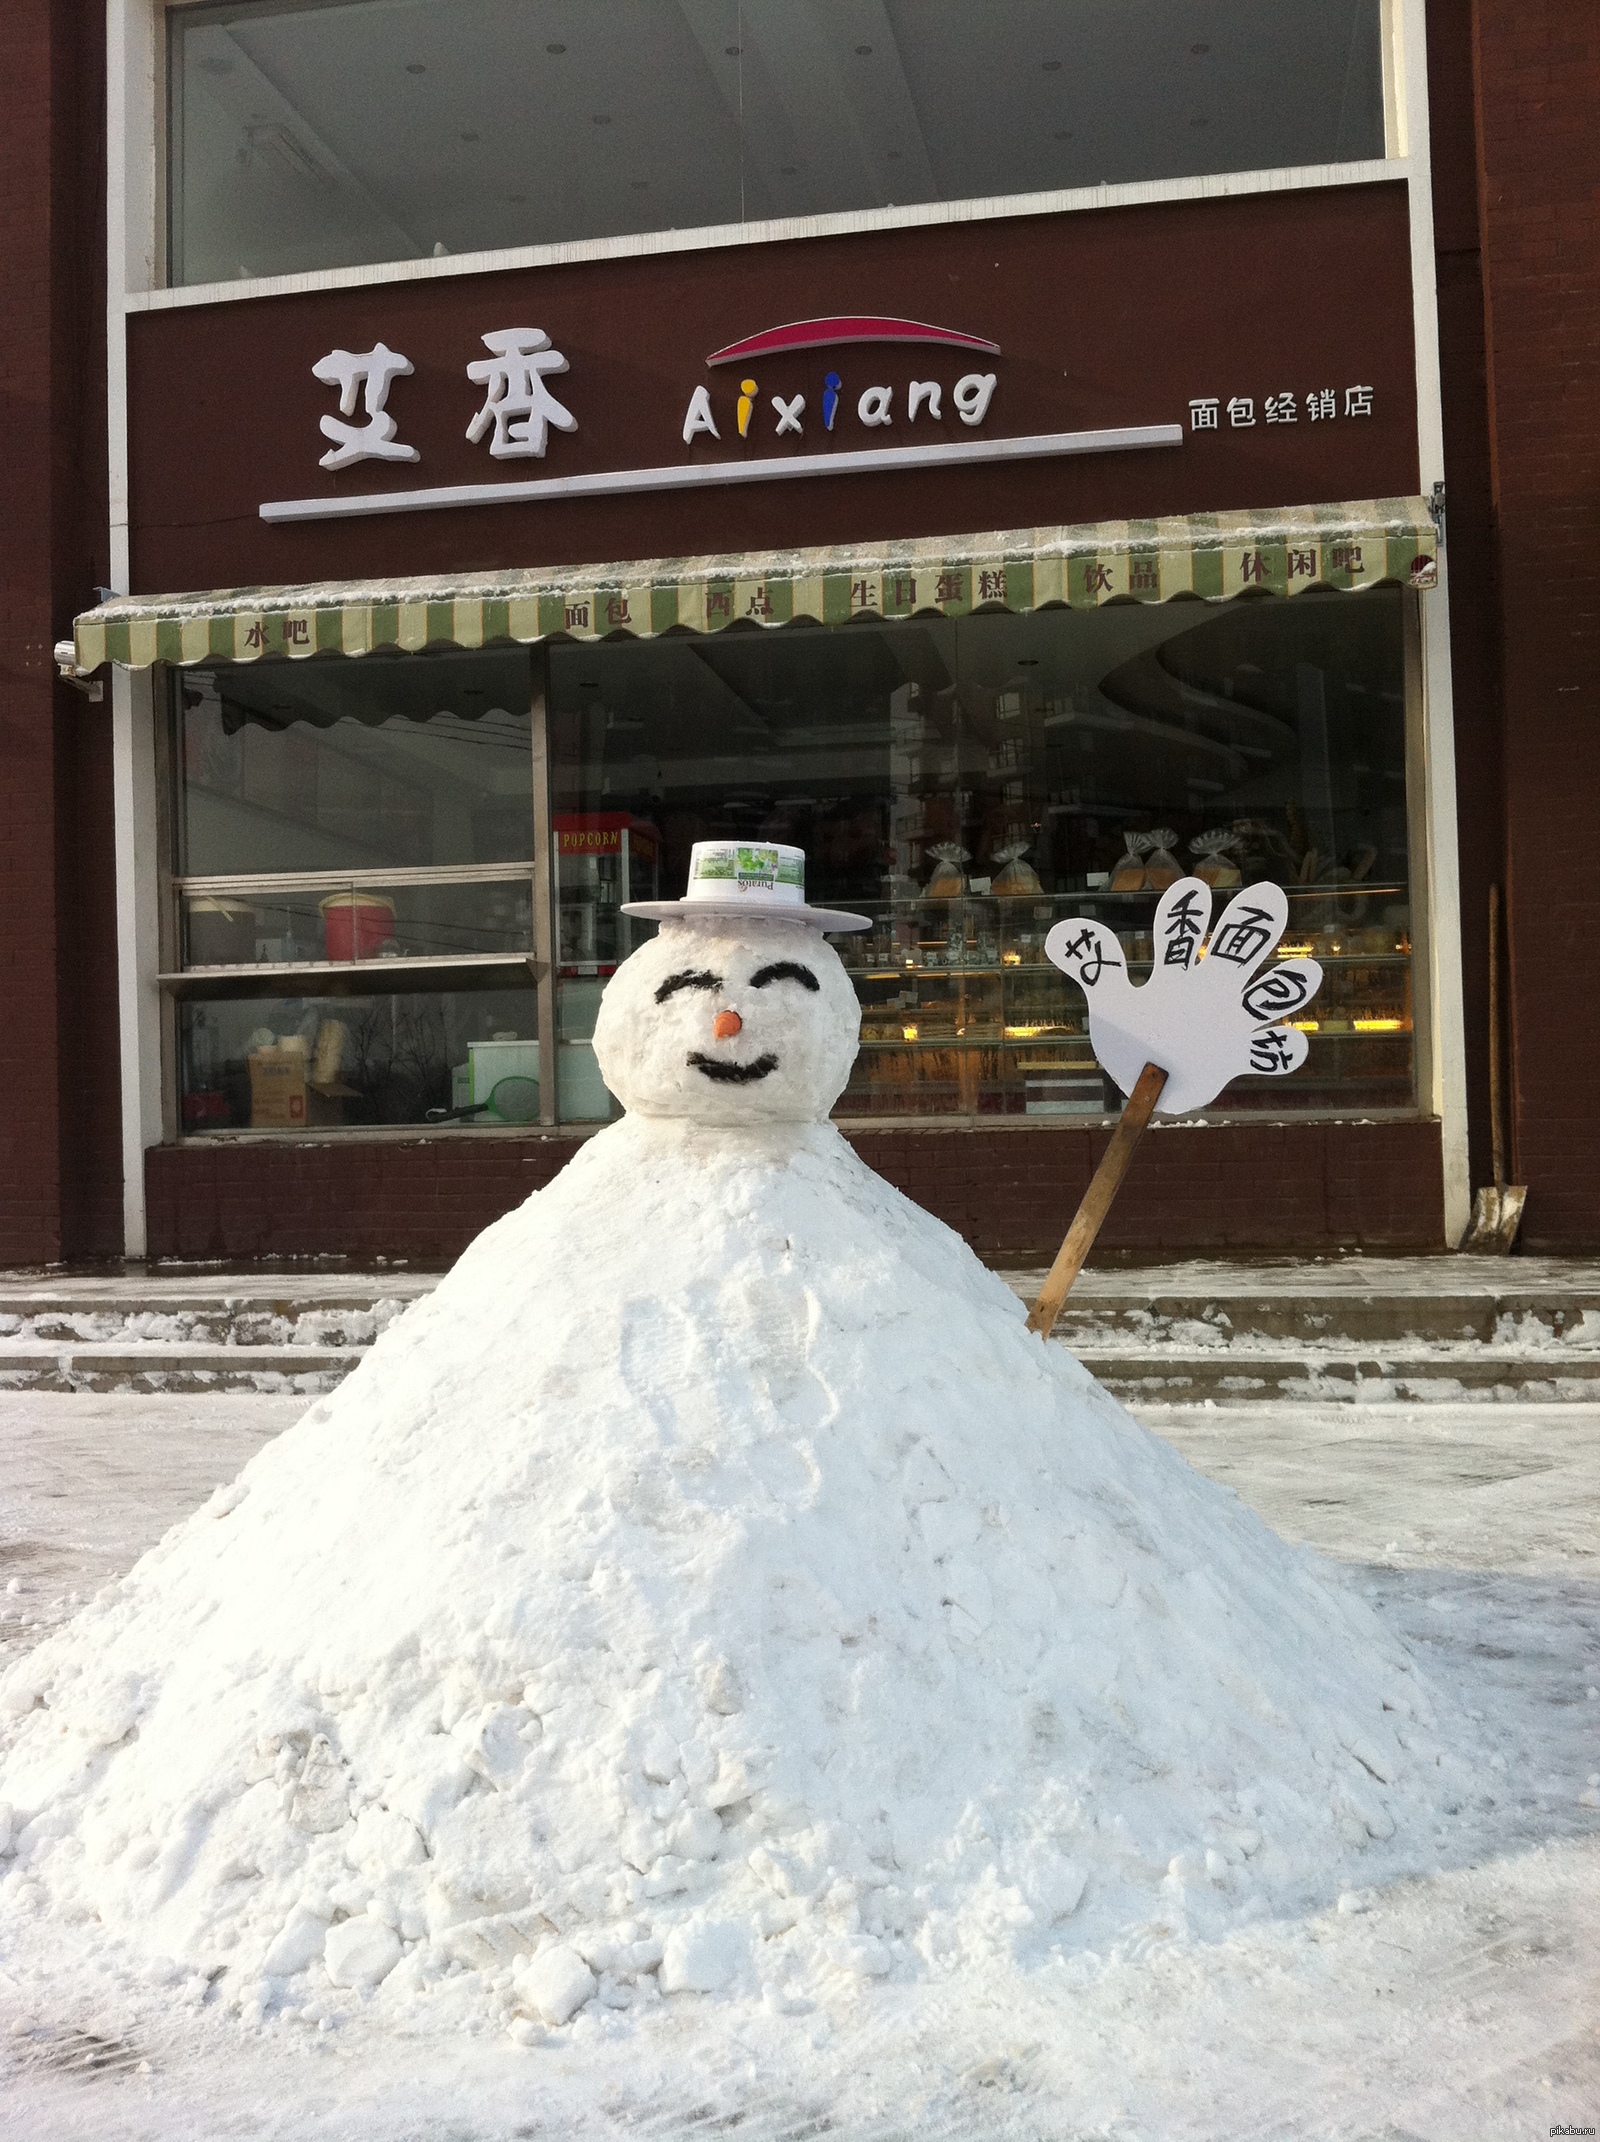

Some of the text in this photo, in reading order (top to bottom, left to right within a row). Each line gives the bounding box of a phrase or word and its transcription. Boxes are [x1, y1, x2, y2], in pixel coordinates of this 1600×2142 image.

[312, 327, 578, 471] 艾香
[683, 371, 997, 445] Aixiang
[1188, 385, 1374, 431] 面包经销店
[244, 546, 1365, 648] 水吧 面包 西点 生日蛋糕 饮品 休闲吧
[563, 831, 618, 848] POPCORN
[738, 880, 774, 891] Puratos
